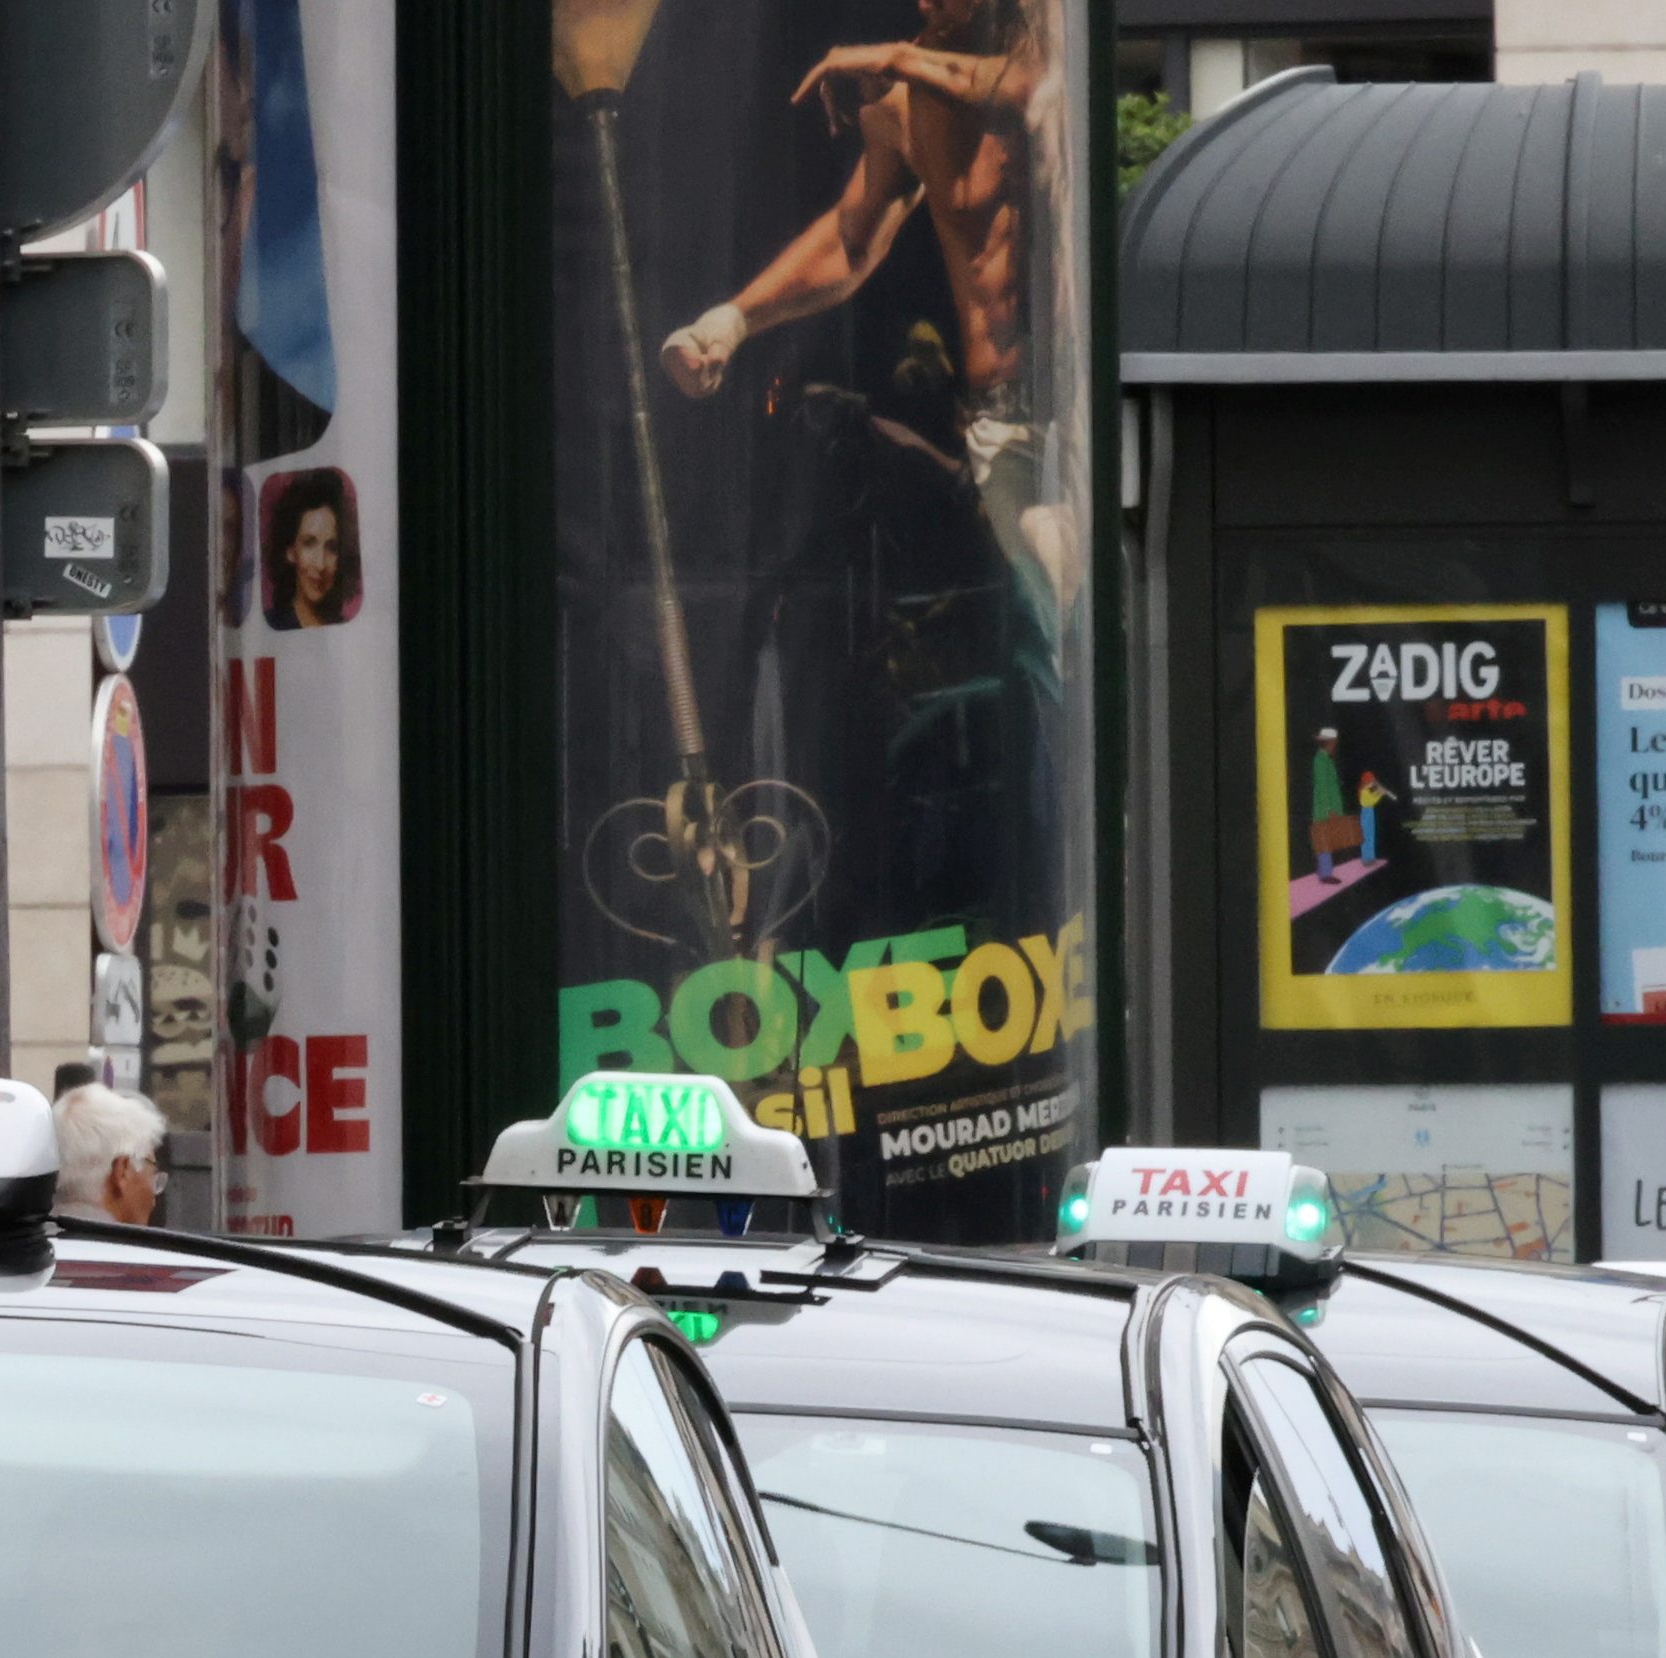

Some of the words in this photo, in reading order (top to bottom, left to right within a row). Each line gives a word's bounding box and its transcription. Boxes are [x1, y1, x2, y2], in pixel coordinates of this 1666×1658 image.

[1331, 641, 1500, 702] ZADIG
[1447, 697, 1528, 721] arte
[1426, 736, 1511, 765] RÊVER
[1410, 762, 1526, 789] L'EUROPE
[581, 1084, 707, 1147] TAXI
[756, 1066, 857, 1140] sil
[880, 1109, 1012, 1161] MOURAD
[557, 1148, 733, 1180] PARISIEN
[947, 1137, 1036, 1178] QUATUOR
[1132, 1167, 1249, 1198] TAXI
[1112, 1200, 1271, 1220] PARISIEN
